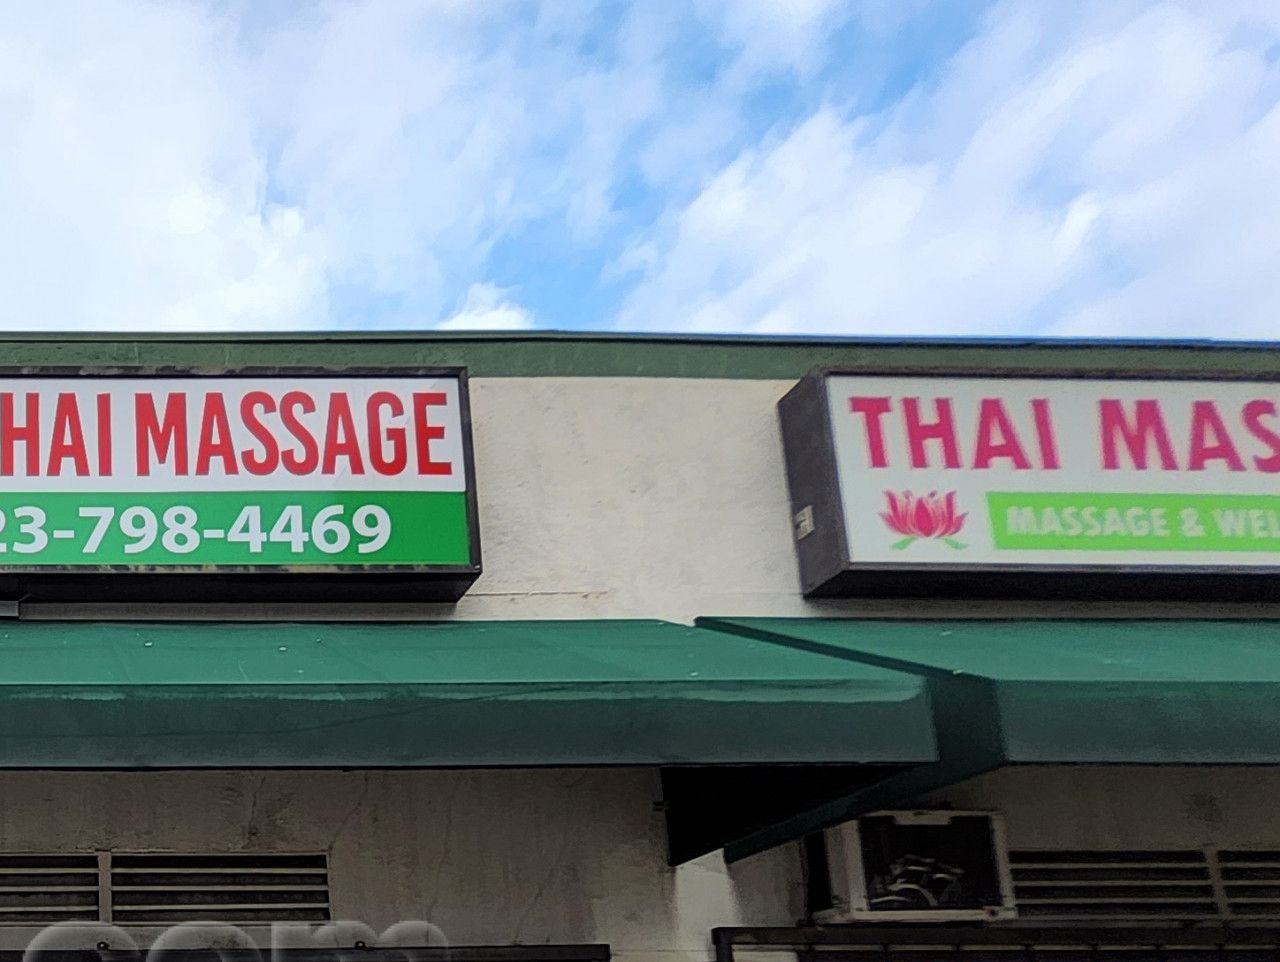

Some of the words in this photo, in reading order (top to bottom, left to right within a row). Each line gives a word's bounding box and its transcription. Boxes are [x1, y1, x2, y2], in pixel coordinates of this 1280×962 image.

[134, 391, 453, 477] MASSAGE
[848, 396, 1061, 470] THAI
[1006, 506, 1170, 537] MASSAGE
[1179, 507, 1206, 537] &
